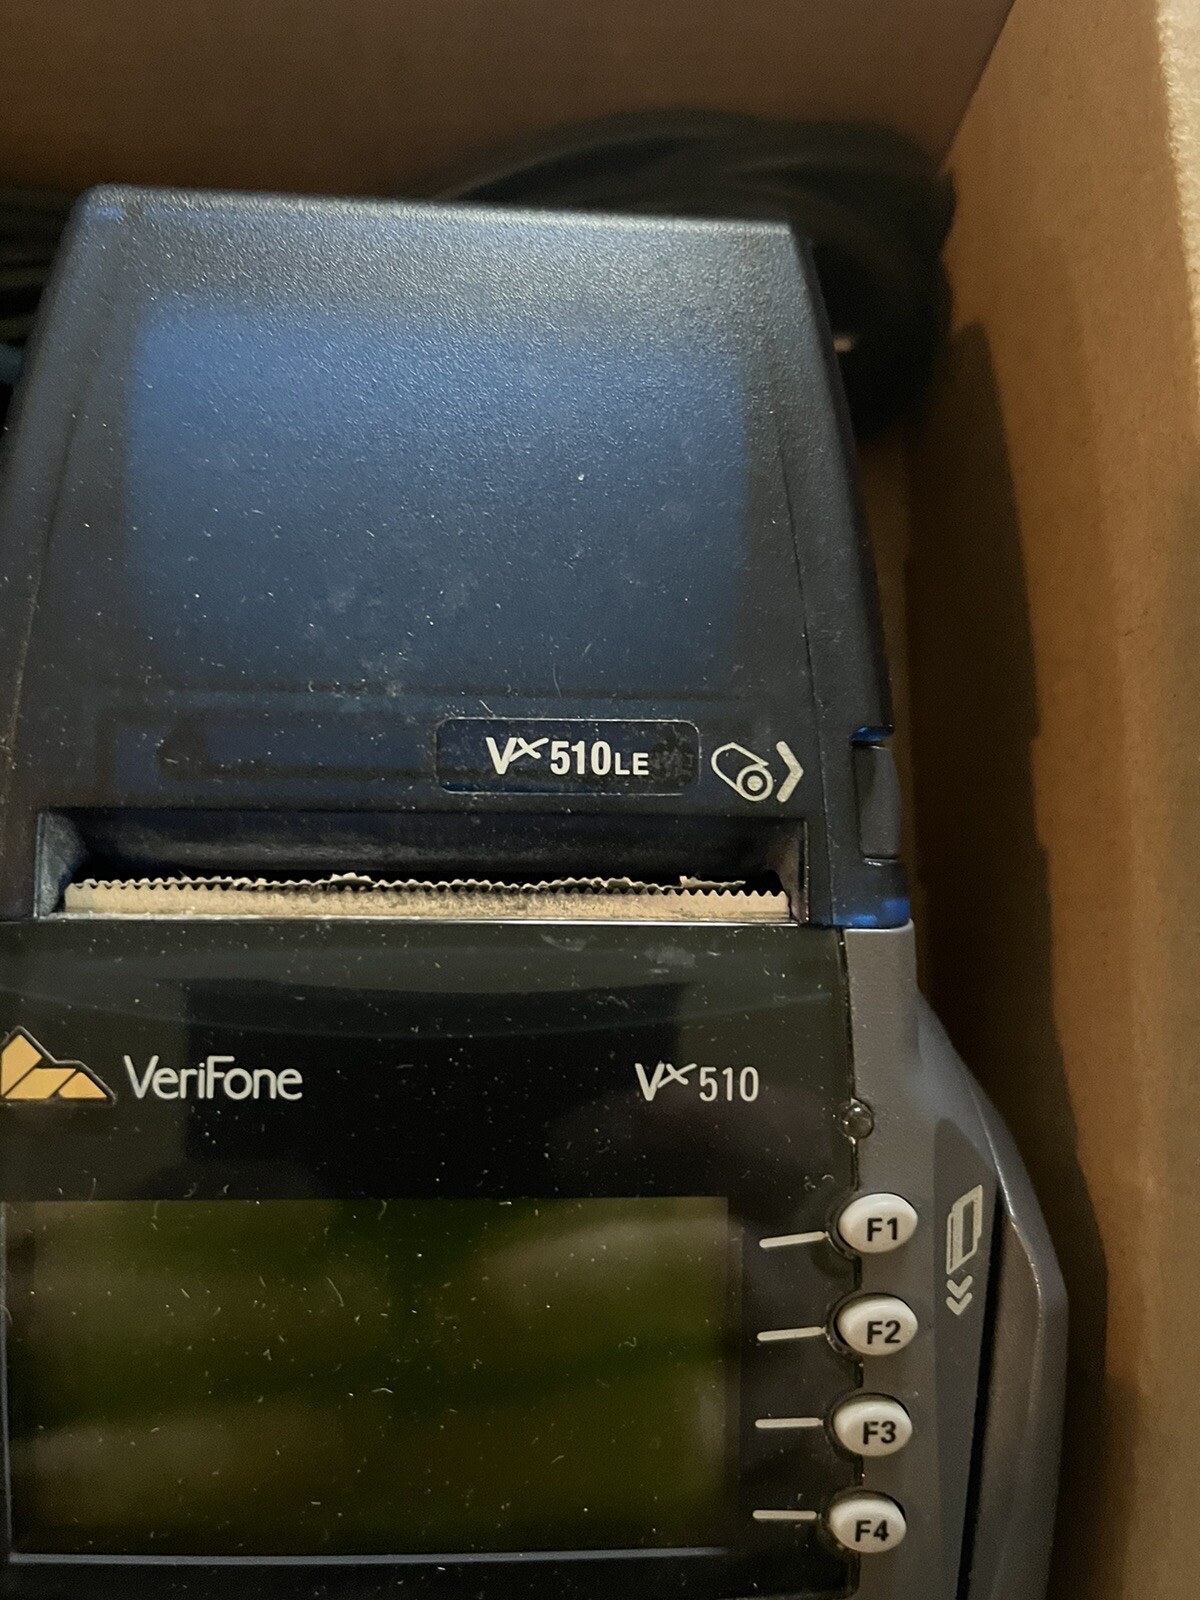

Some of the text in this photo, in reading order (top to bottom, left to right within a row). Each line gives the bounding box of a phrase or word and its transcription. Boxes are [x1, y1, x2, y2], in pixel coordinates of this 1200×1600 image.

[123, 1055, 303, 1100] VeriFone
[866, 1217, 898, 1242] F1
[866, 1319, 901, 1345] F2
[862, 1420, 897, 1445] F3
[854, 1519, 889, 1543] F4
